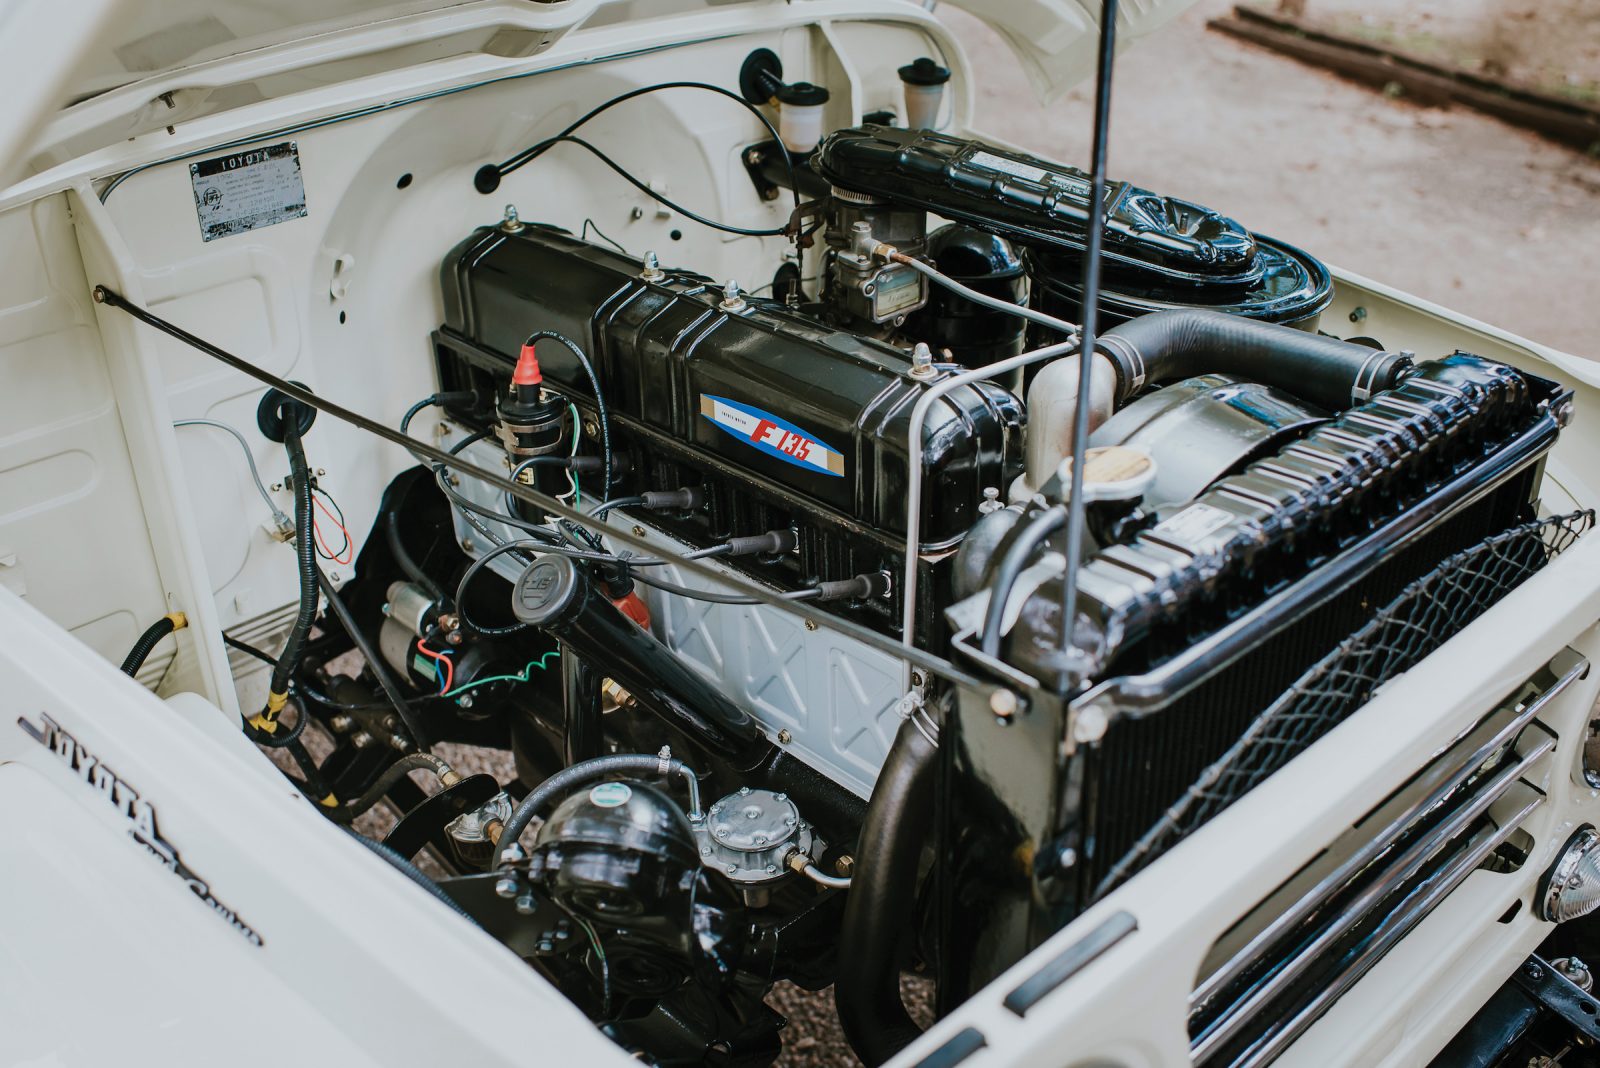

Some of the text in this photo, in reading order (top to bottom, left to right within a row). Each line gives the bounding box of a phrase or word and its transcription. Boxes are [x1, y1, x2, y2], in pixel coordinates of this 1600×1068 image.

[222, 151, 270, 170] TOYOTA
[750, 418, 816, 461] F 135
[39, 711, 161, 840] TOYOTA
